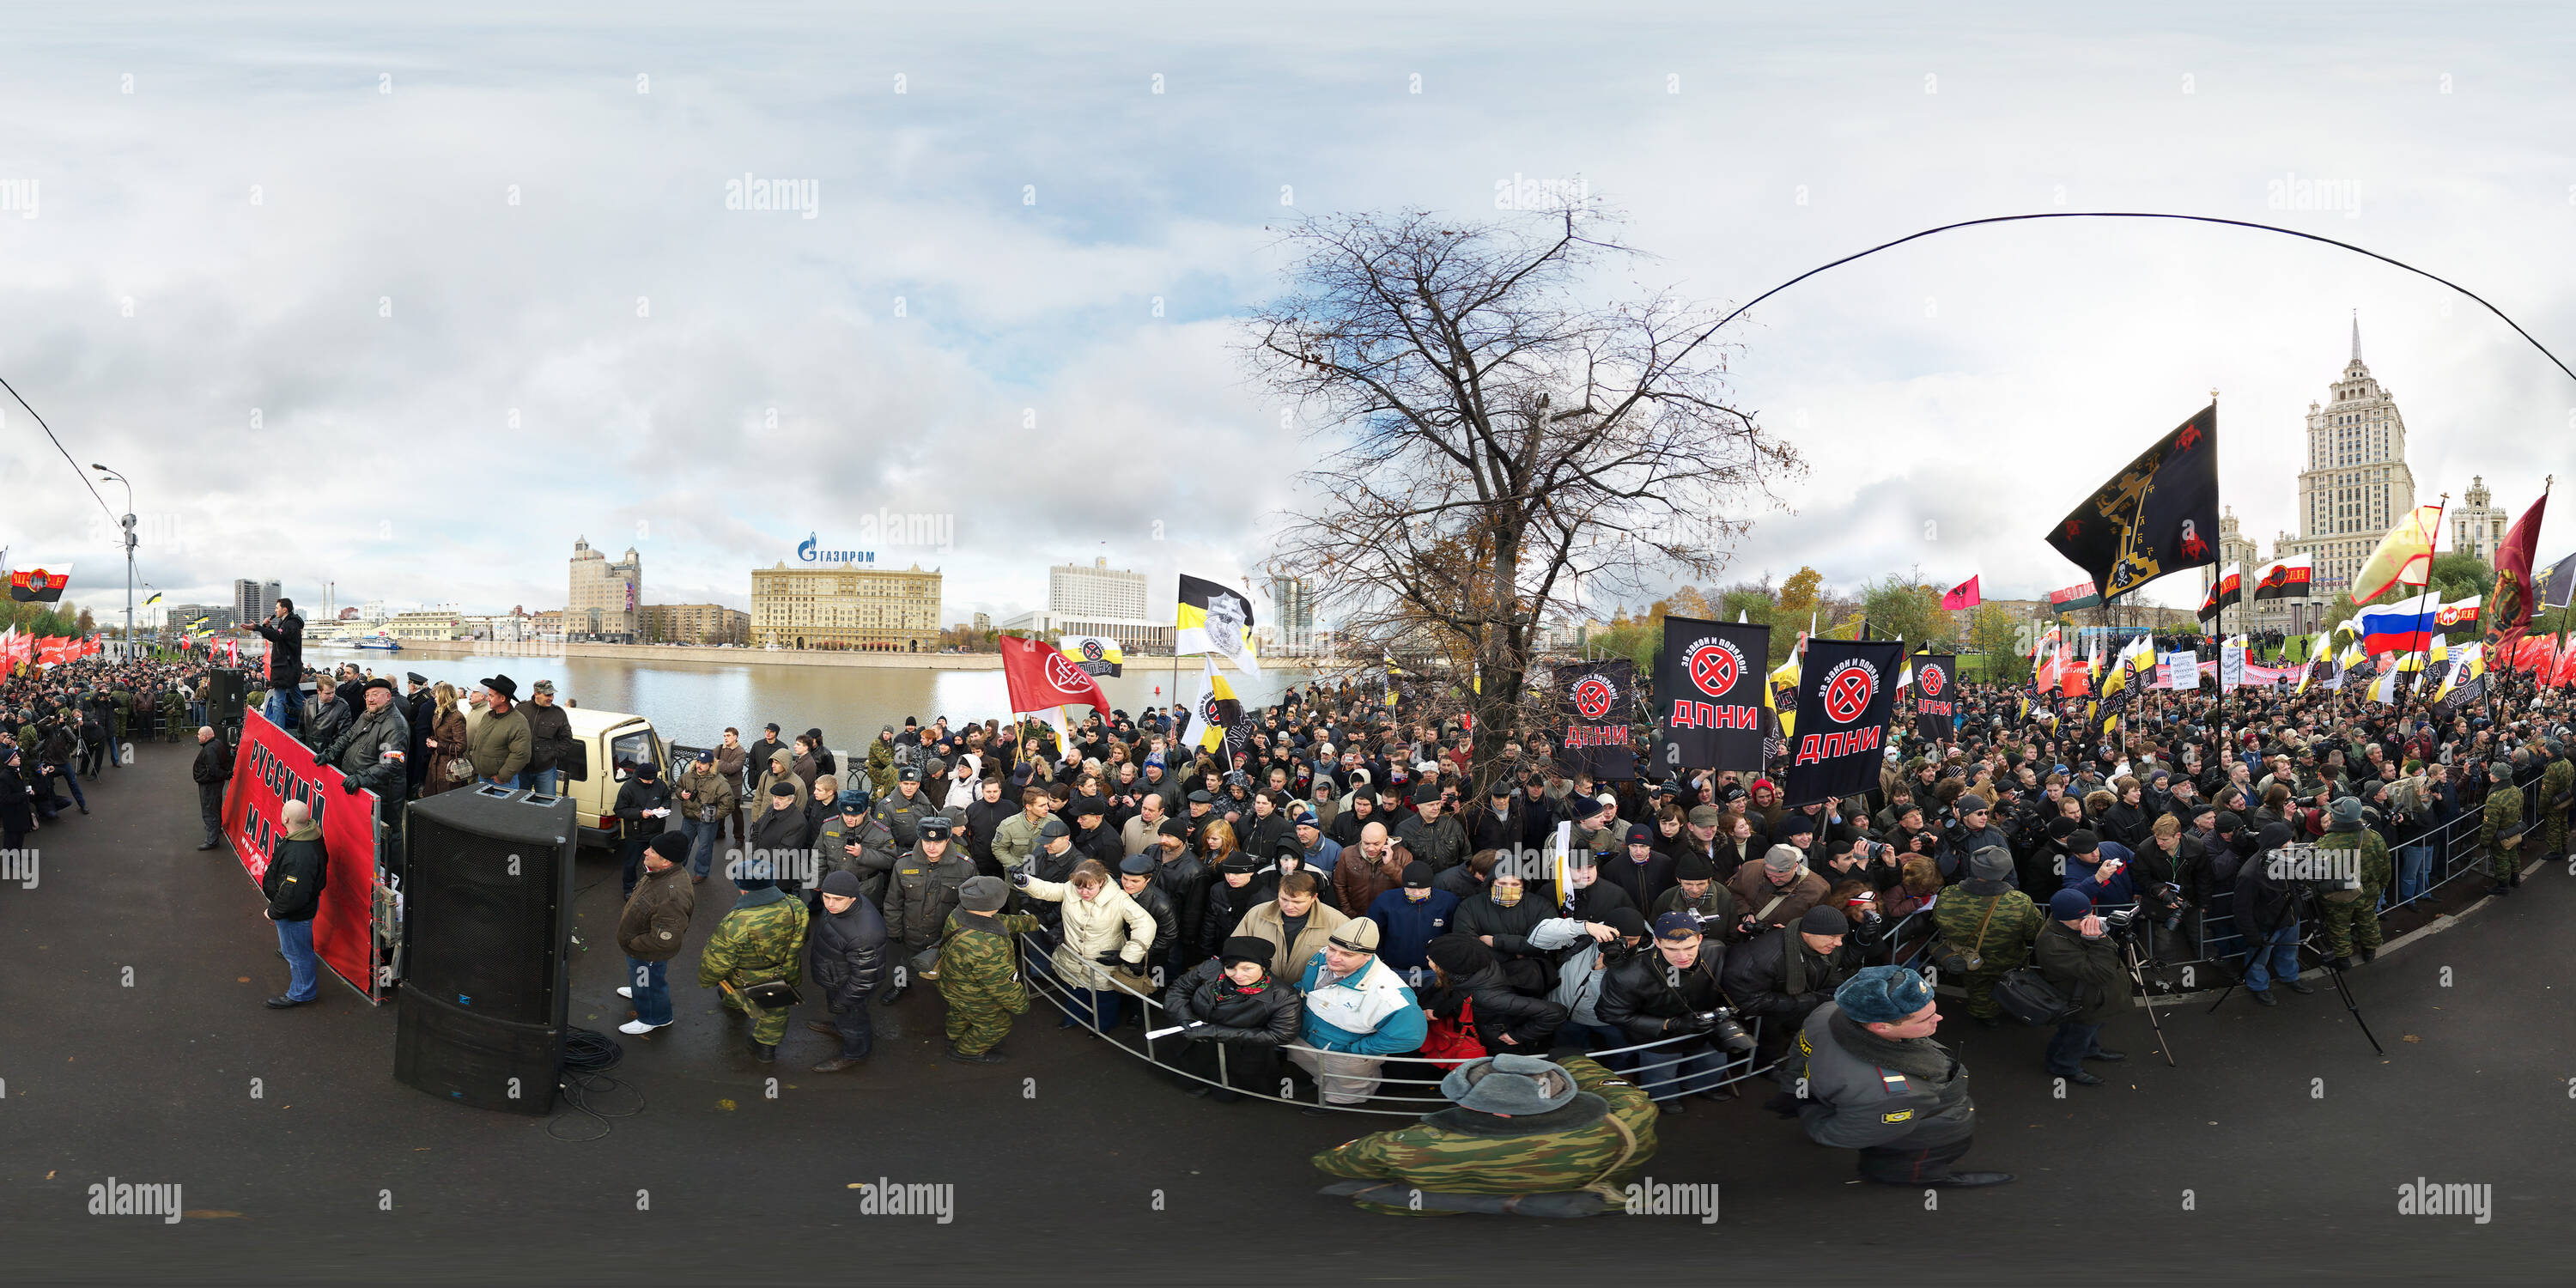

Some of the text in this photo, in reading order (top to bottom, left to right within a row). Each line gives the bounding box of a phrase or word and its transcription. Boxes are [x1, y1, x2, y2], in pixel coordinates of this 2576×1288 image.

[820, 550, 874, 562] ГАЗПРОМ
[1671, 699, 1758, 731] ДПНИ
[1917, 697, 1952, 717] ДПНИ
[1564, 725, 1628, 749] ДПНИ
[1795, 725, 1881, 767] ДПНИ
[249, 738, 326, 837] РУССКИЙ
[244, 801, 283, 860] МАР
